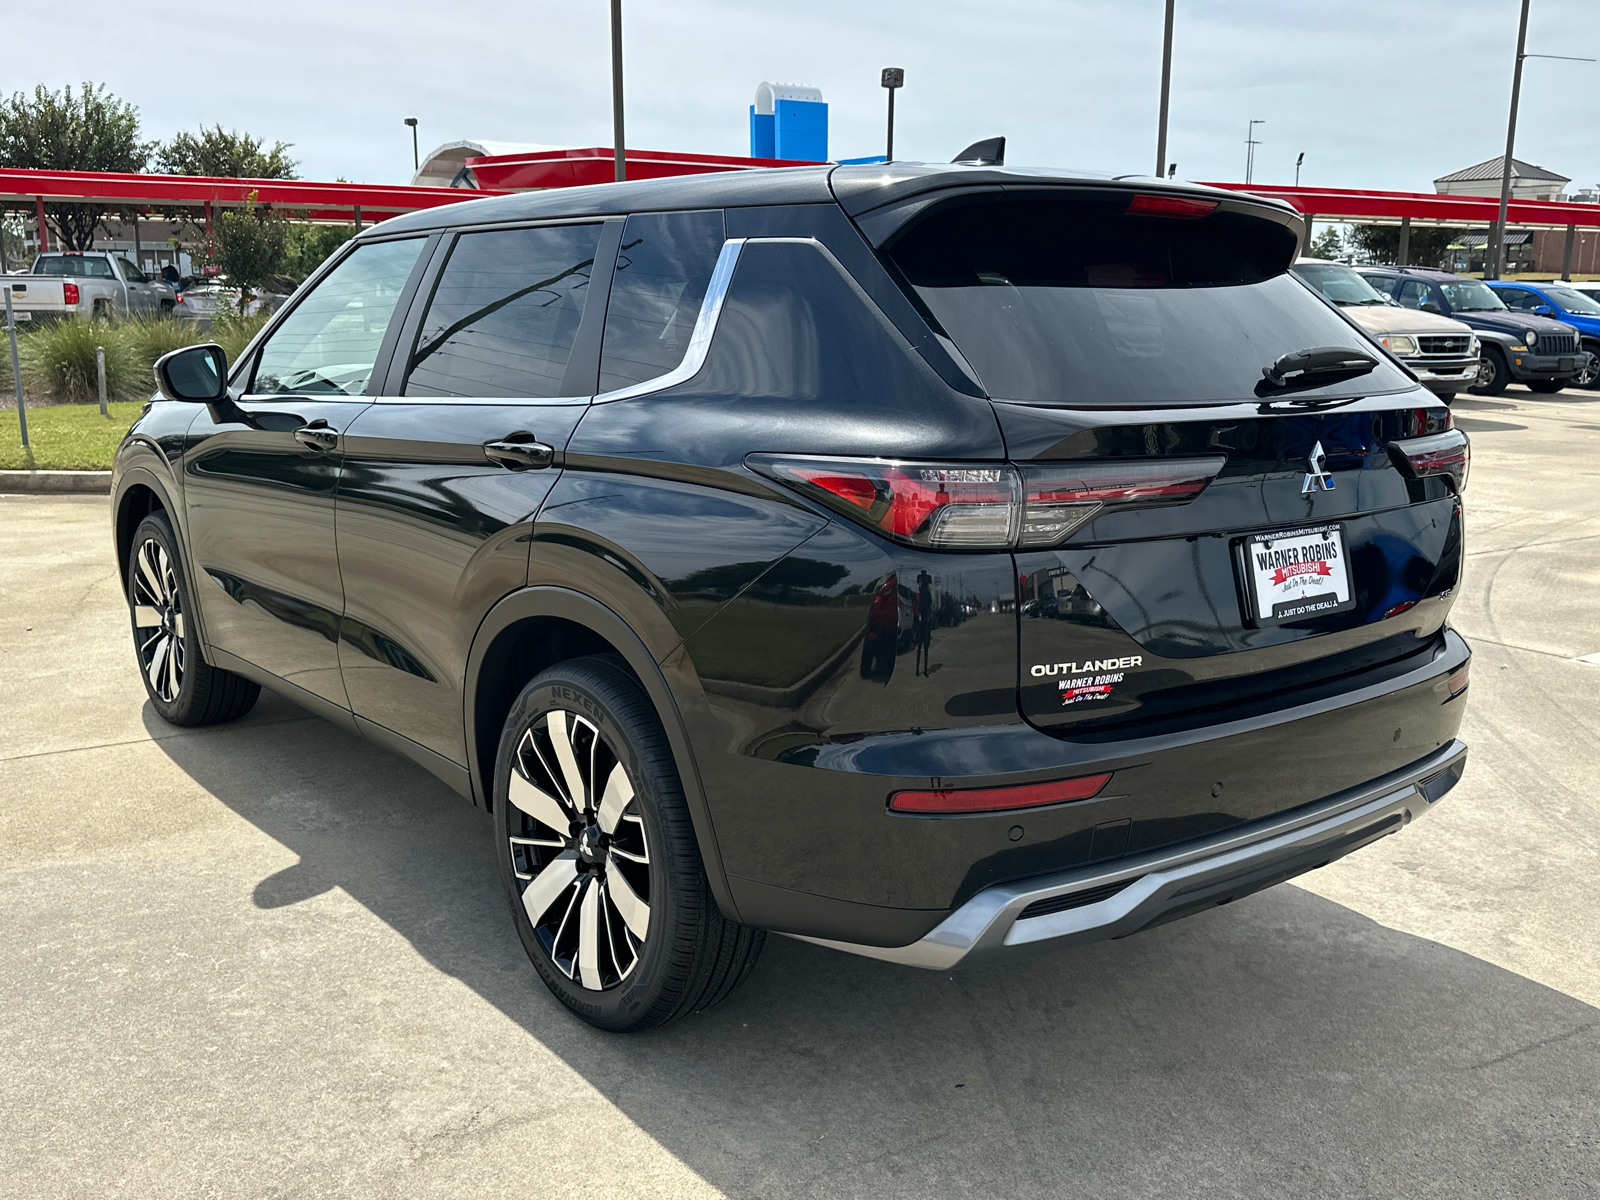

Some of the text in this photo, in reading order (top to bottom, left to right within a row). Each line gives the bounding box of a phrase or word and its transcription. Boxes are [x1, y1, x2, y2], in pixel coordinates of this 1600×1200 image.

[1256, 541, 1338, 571] WARNER ROBINS
[1281, 562, 1320, 578] MITSUBISHI
[1282, 580, 1292, 593] Just
[1292, 578, 1299, 588] Do
[1299, 577, 1308, 586] The
[1283, 603, 1333, 617] JUST DO THE DEAL!
[1030, 655, 1143, 677] OUTLANDER
[1058, 672, 1124, 690] WARNER ROBINS
[1072, 685, 1105, 695] MITSUBISHI
[551, 686, 605, 724] NEXEN
[1062, 697, 1075, 706] Just
[548, 978, 603, 1016] ROADIAN
